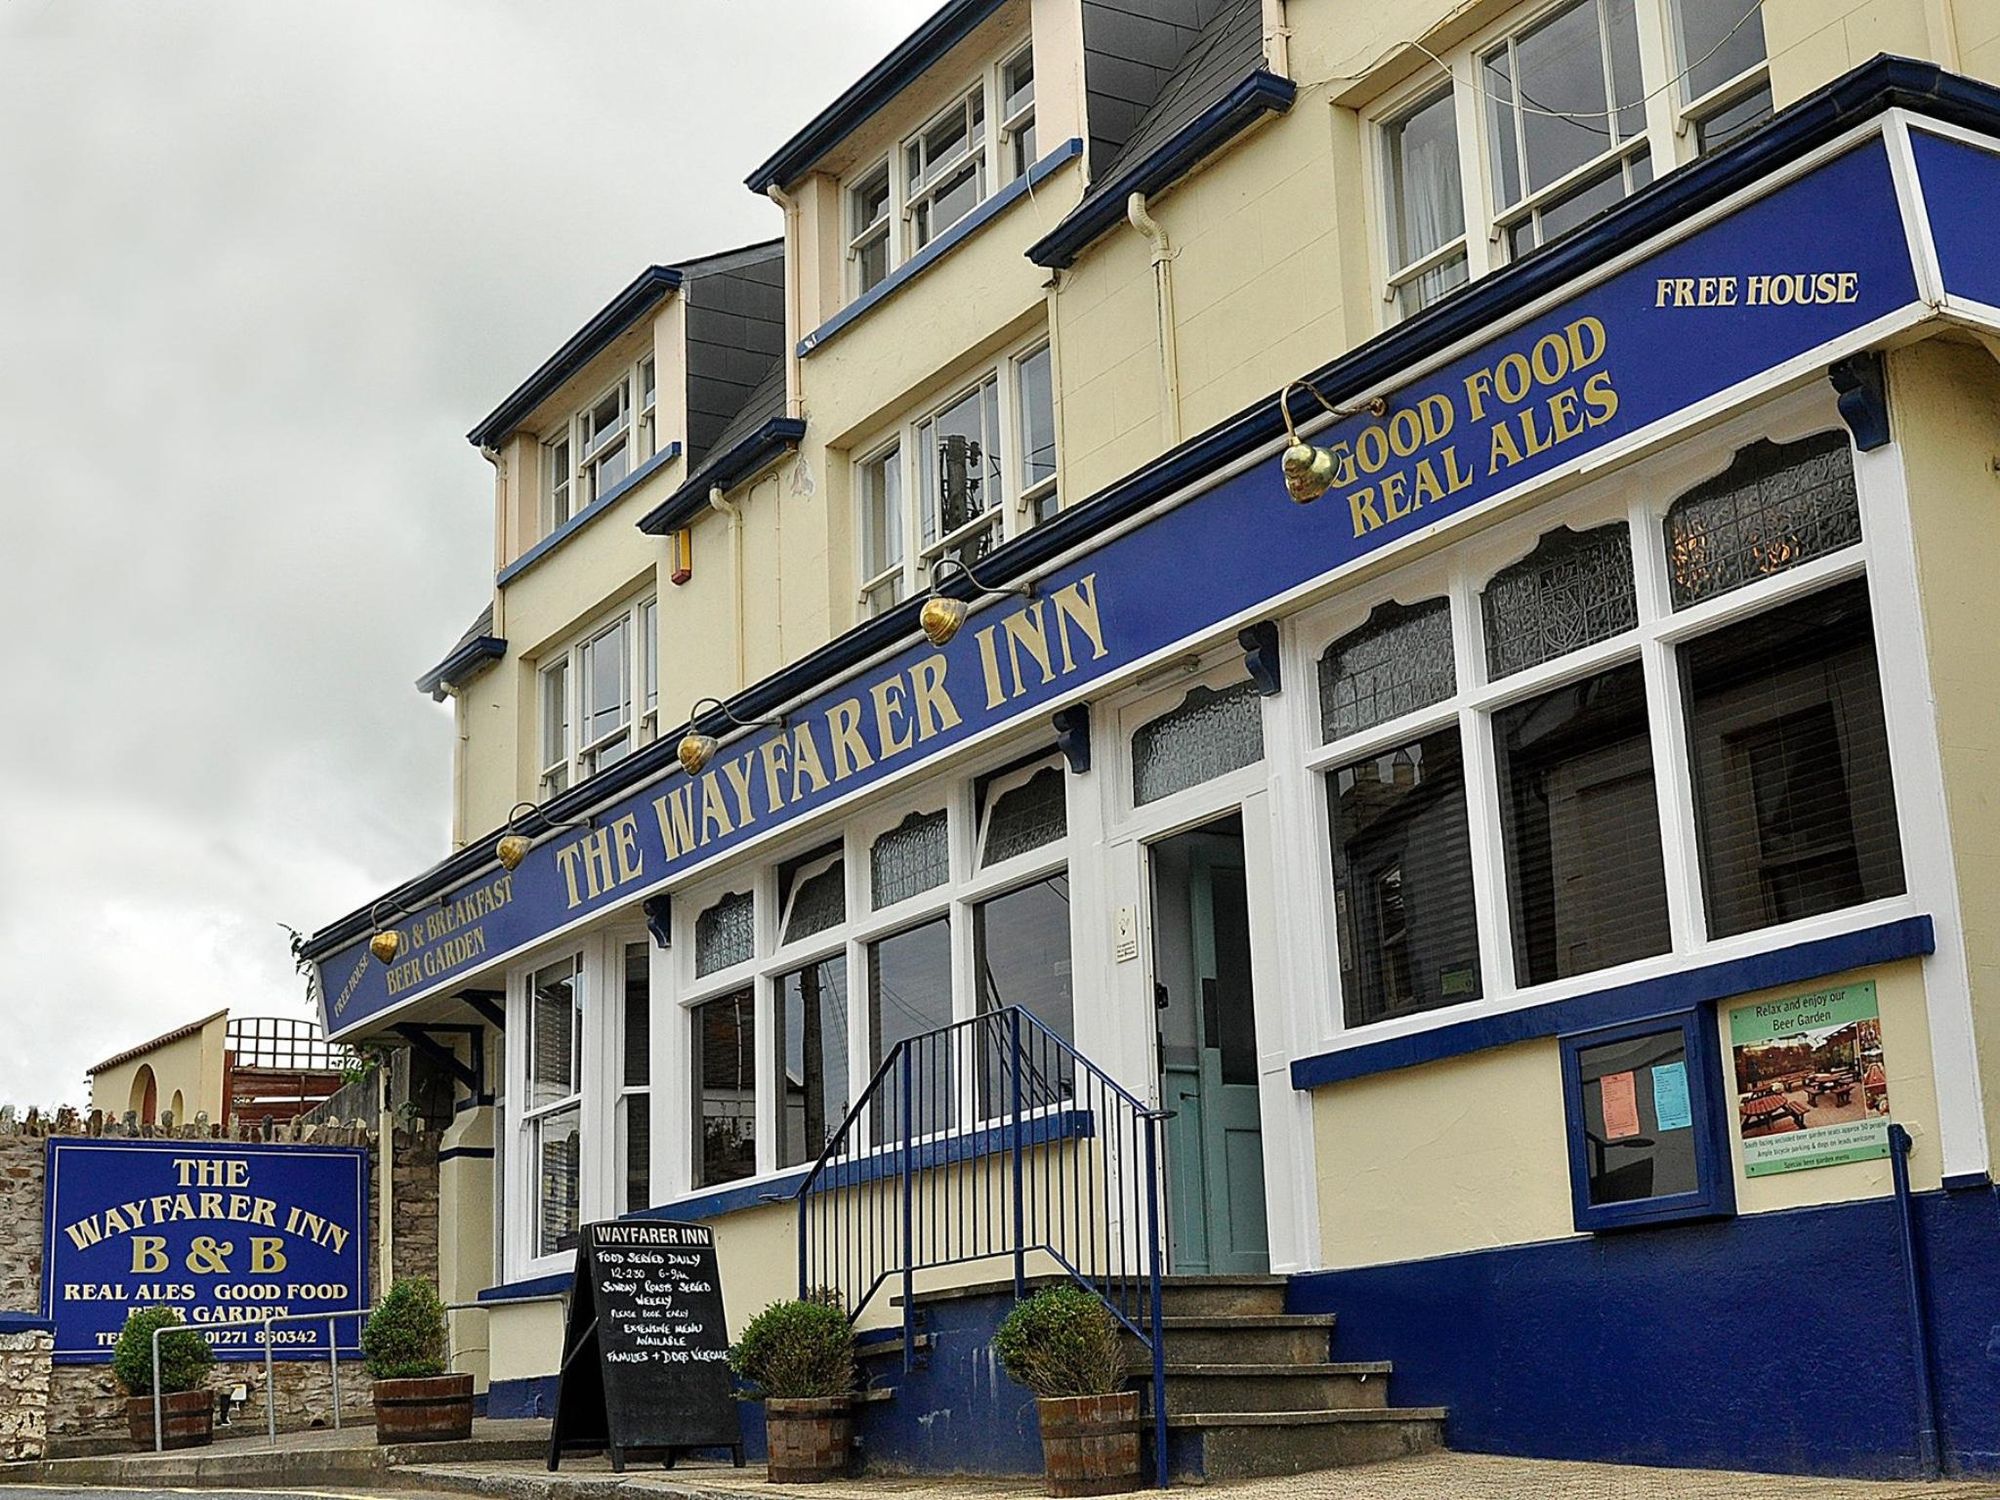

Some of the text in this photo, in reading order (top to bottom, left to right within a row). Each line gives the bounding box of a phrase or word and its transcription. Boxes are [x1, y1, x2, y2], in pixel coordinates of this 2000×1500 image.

[1654, 271, 1860, 309] FREE HOUSE
[1331, 315, 1607, 489] GOOD FOOD
[1346, 369, 1620, 539] REAL ALES
[556, 571, 1109, 911] THE WAYFARER INN
[412, 923, 424, 948] &
[426, 875, 513, 941] BREAKFAST
[386, 958, 423, 996] BEER
[424, 925, 486, 977] GARDEN
[1756, 990, 1846, 1018] Relax and enjoy our
[1773, 1010, 1831, 1031] Beer Garden
[172, 1158, 250, 1188] THE
[64, 1193, 350, 1255] WAYFARER INN
[596, 1226, 709, 1245] WAYFARER INN
[129, 1236, 288, 1274] B & B
[596, 1250, 701, 1267] FOOD SERVED DAILY
[63, 1283, 348, 1301] REAL ALES GOOD FOOD
[192, 1305, 289, 1322] GARDEN
[675, 1322, 703, 1334] MENU
[204, 1331, 247, 1344] 01271
